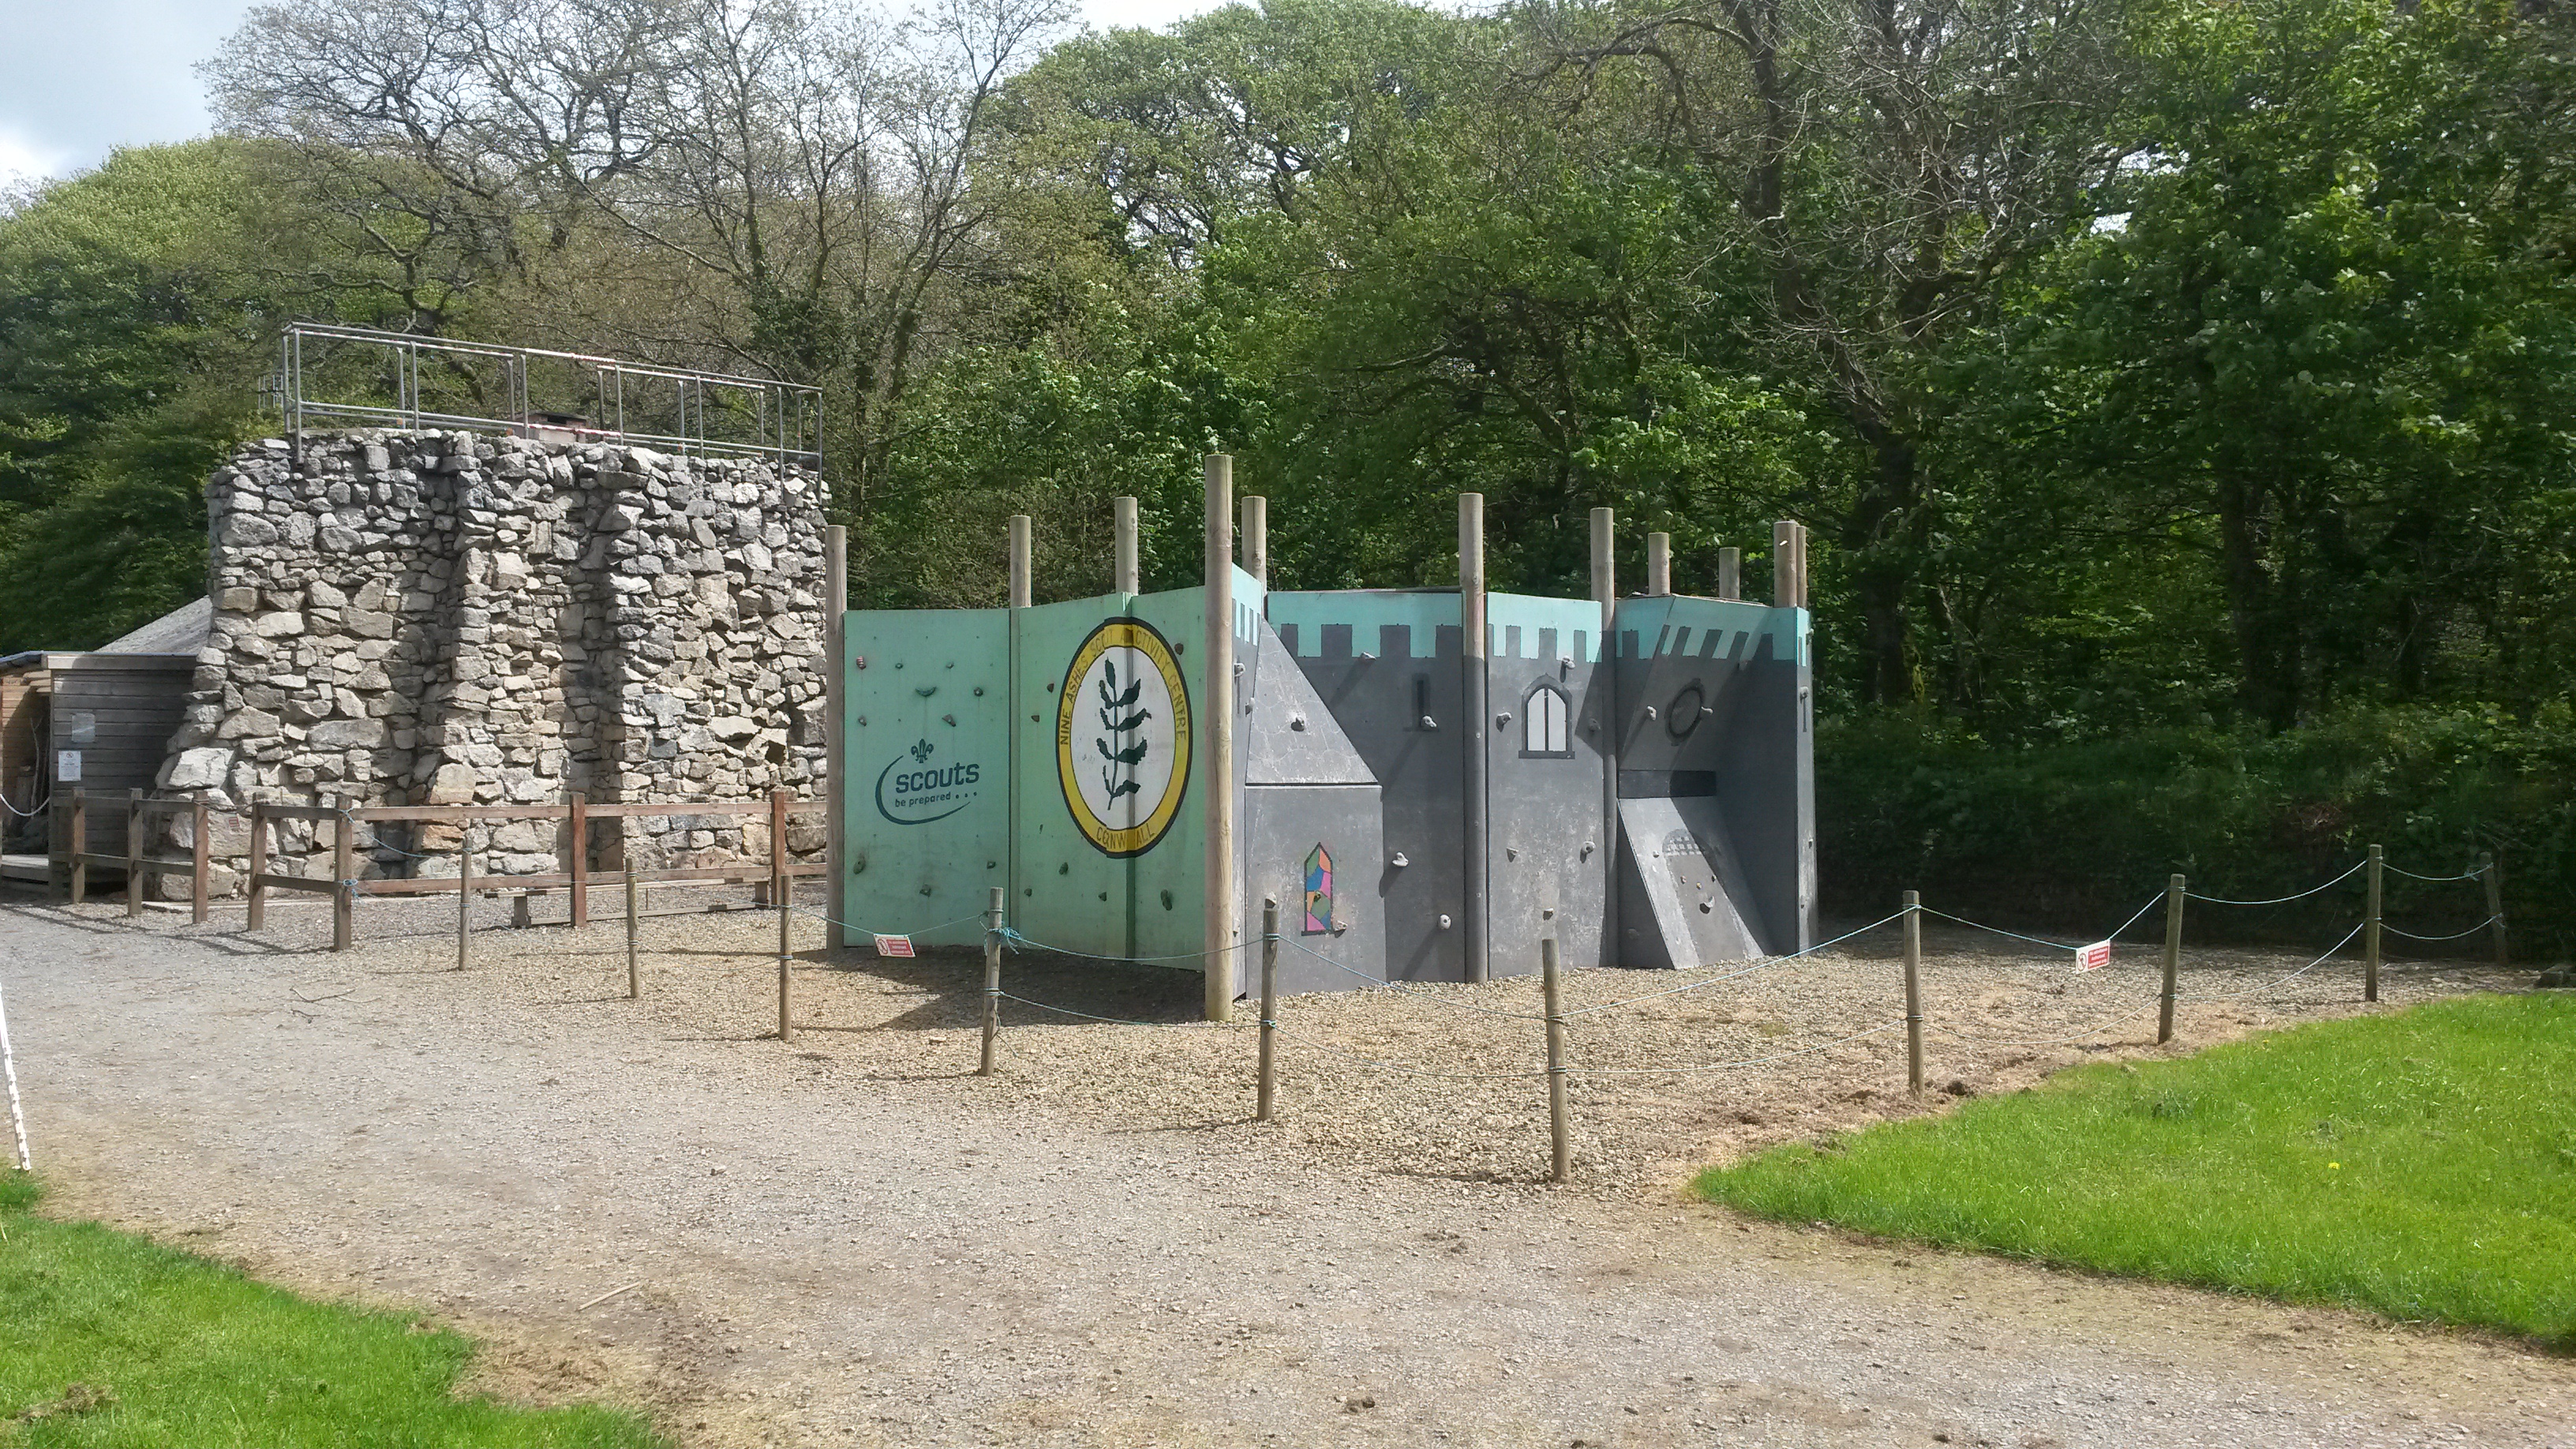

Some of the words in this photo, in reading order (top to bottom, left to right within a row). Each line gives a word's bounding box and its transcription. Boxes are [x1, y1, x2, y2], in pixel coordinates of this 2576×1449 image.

[1065, 655, 1090, 704] ASHES
[1168, 675, 1187, 740] CENTRE
[1060, 709, 1071, 745] NINE
[895, 762, 980, 794] scouts
[895, 799, 907, 807] be
